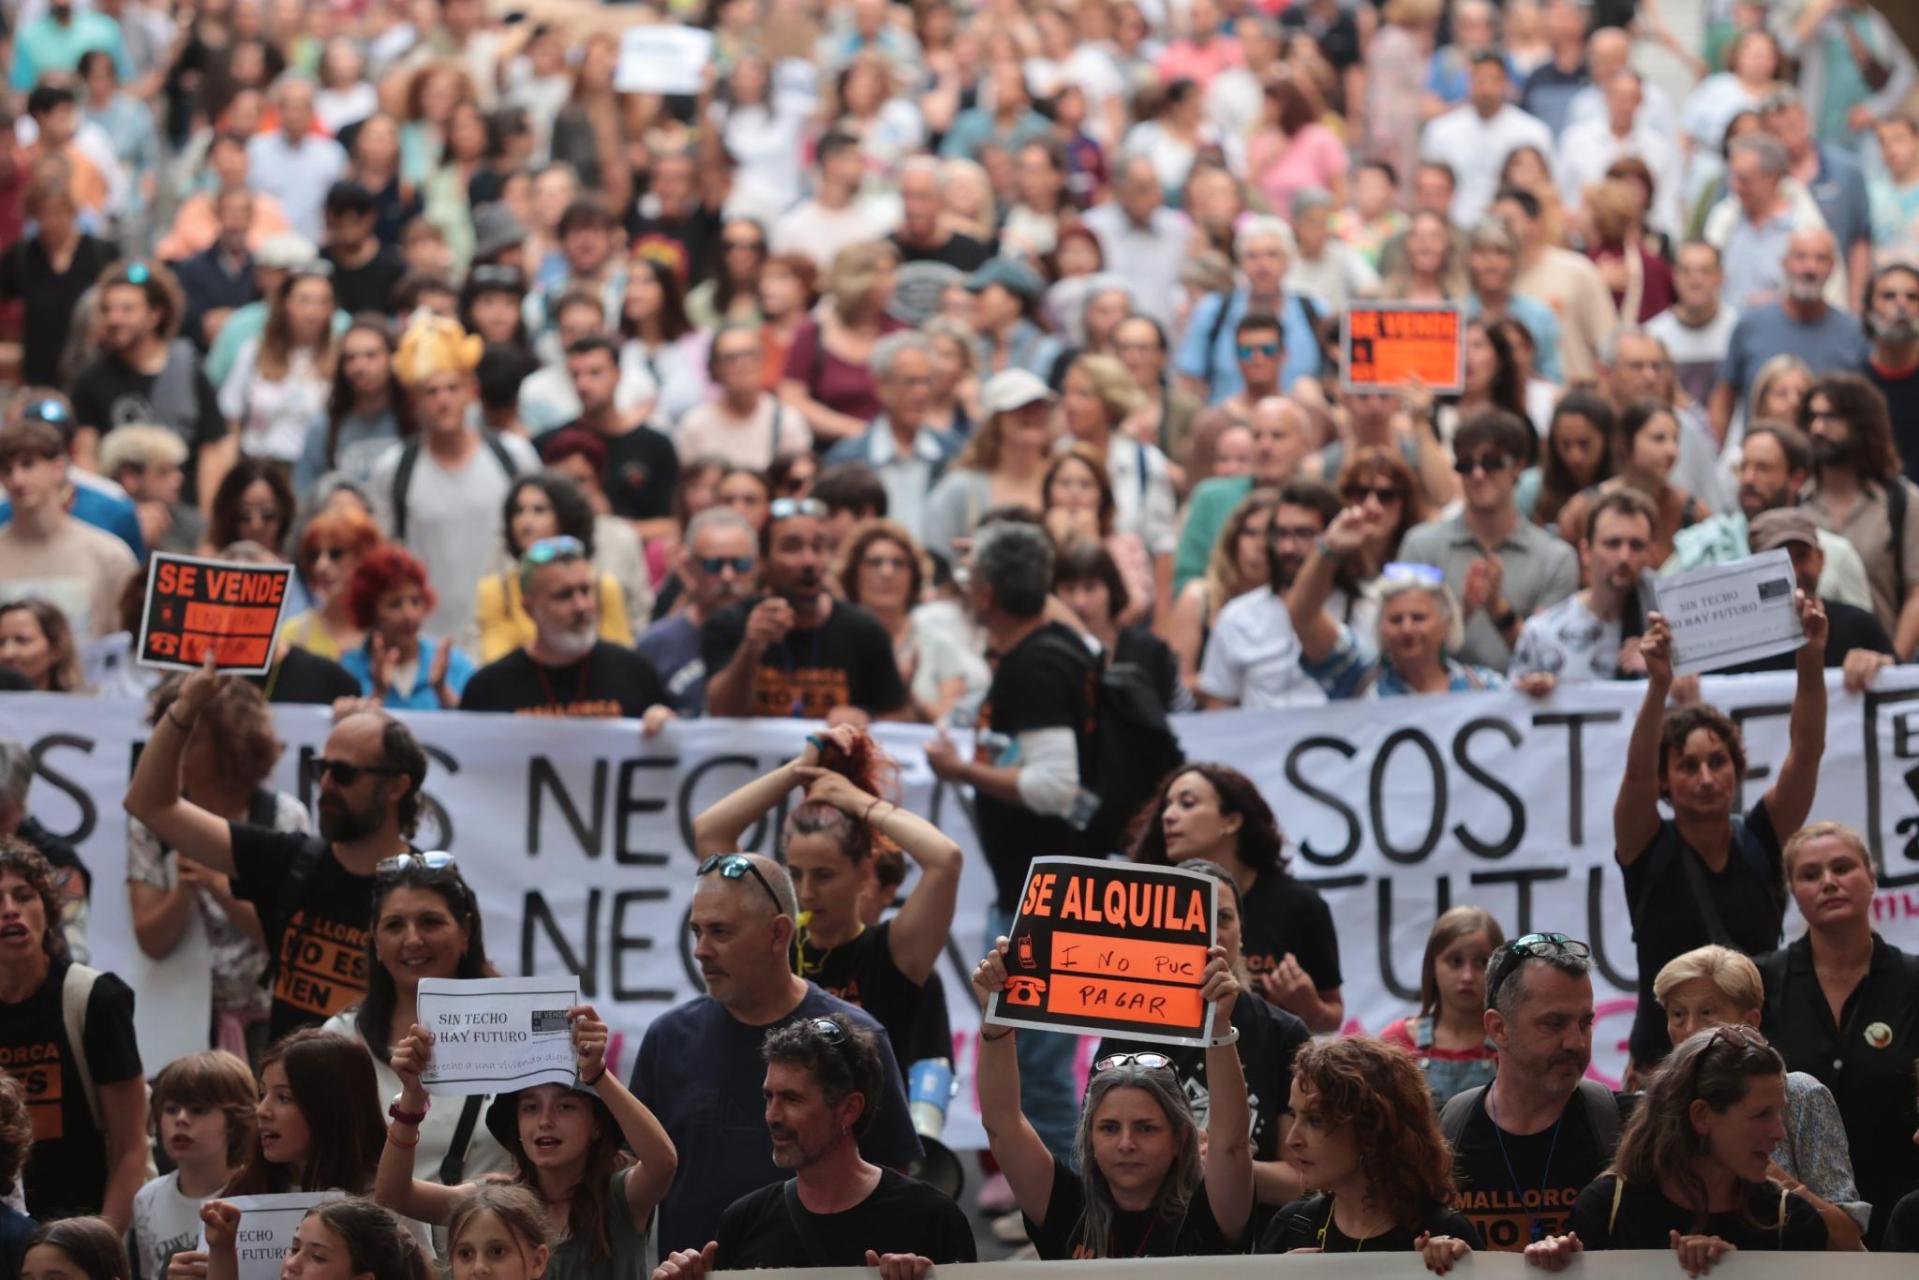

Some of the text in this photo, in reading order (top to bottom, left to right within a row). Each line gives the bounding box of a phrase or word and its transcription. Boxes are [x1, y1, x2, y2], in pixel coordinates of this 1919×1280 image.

[158, 563, 286, 603] SE VENDE
[1679, 591, 1739, 612] SIN TECHO
[1685, 611, 1708, 627] HAY
[1713, 603, 1758, 620] FUTURO
[1022, 873, 1207, 934] SE ALQUILA
[1061, 945, 1195, 976] I NO PUC
[1080, 985, 1167, 1018] PAGAR
[438, 1012, 508, 1025] SIN TECHO
[440, 1030, 471, 1042] HAY
[474, 1030, 528, 1043] FUTURO
[237, 1230, 273, 1242] ECHO
